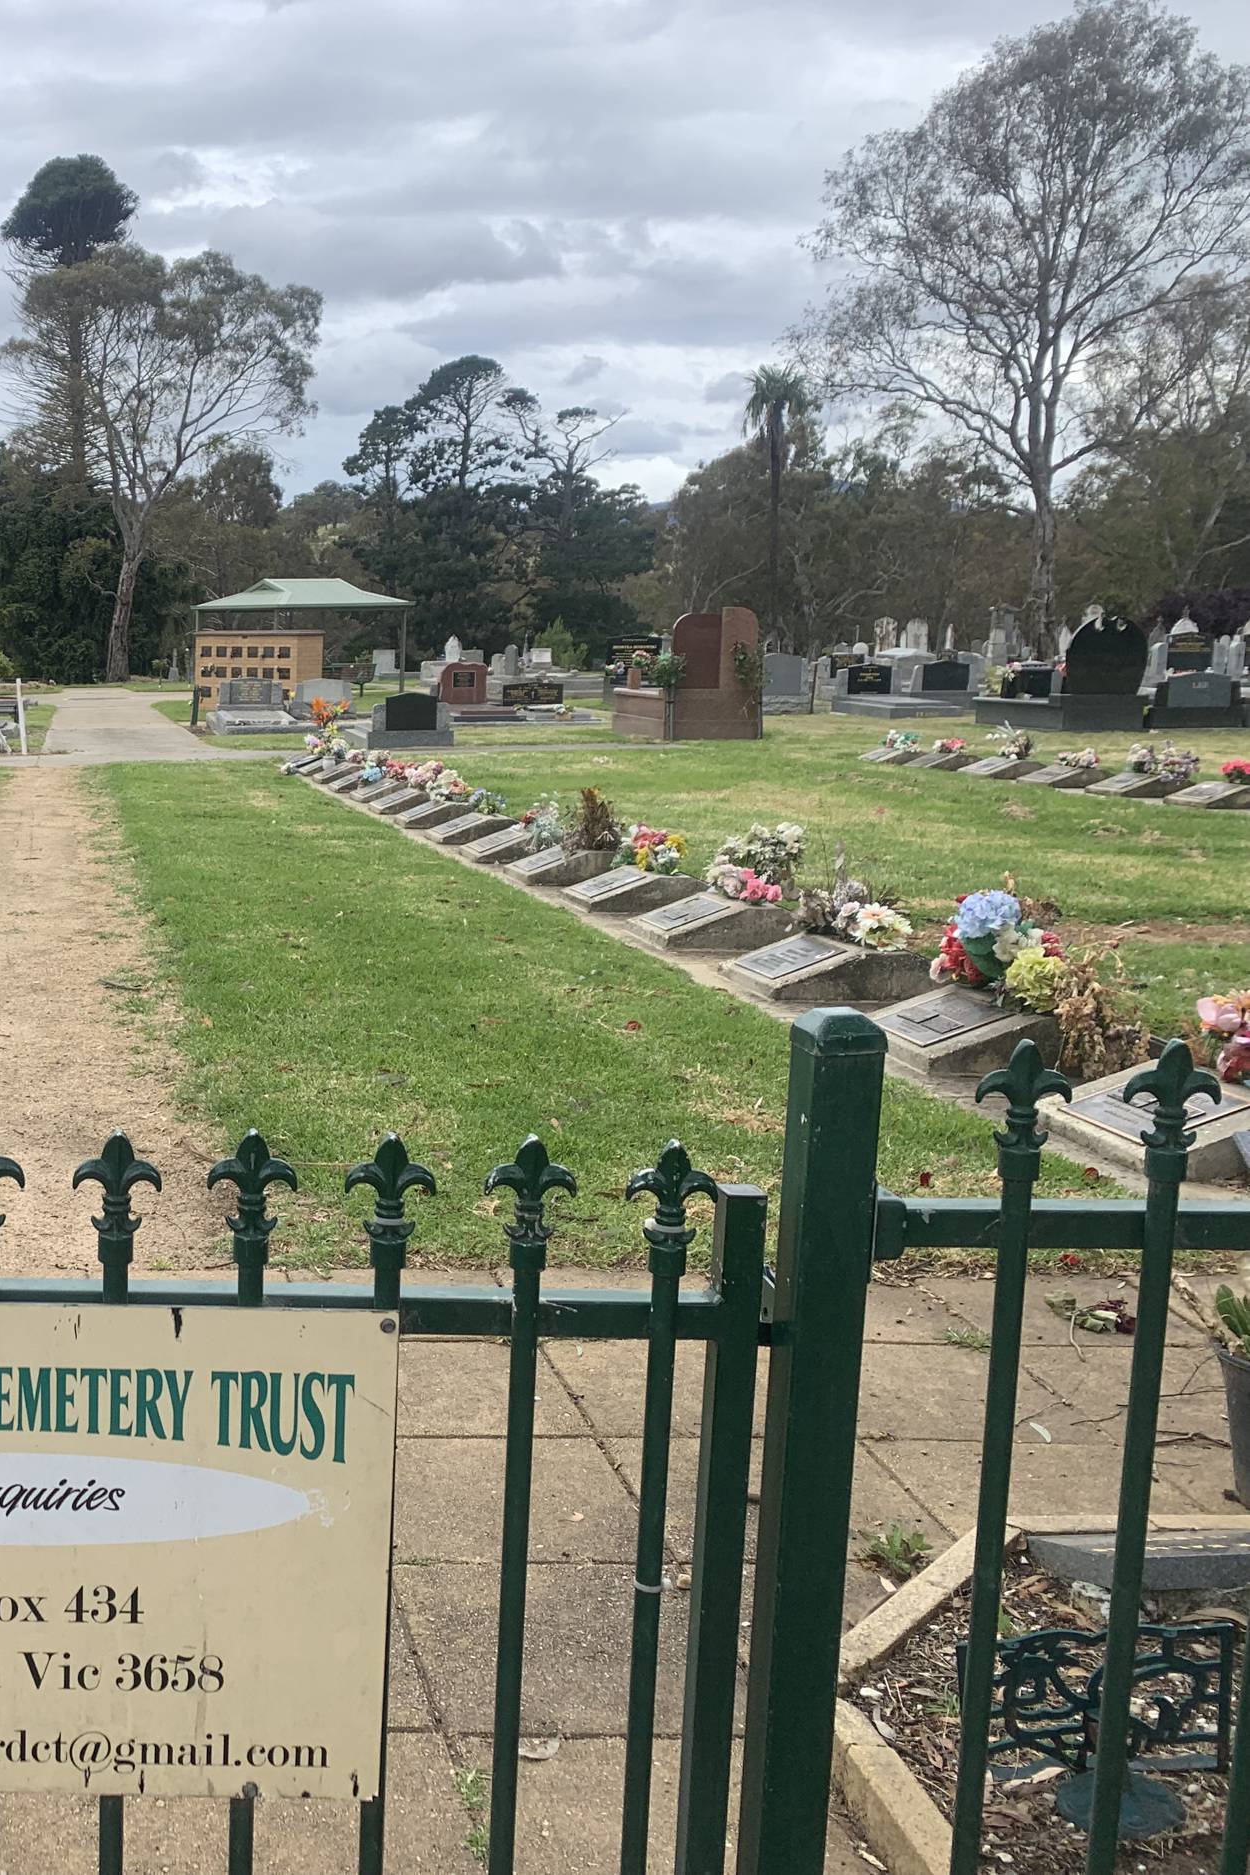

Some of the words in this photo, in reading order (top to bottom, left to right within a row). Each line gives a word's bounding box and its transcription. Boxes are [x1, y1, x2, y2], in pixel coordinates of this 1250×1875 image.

[210, 1370, 356, 1465] TRUST
[64, 1585, 145, 1624] 434
[18, 1651, 100, 1691] Vic
[115, 1653, 225, 1693] 3658
